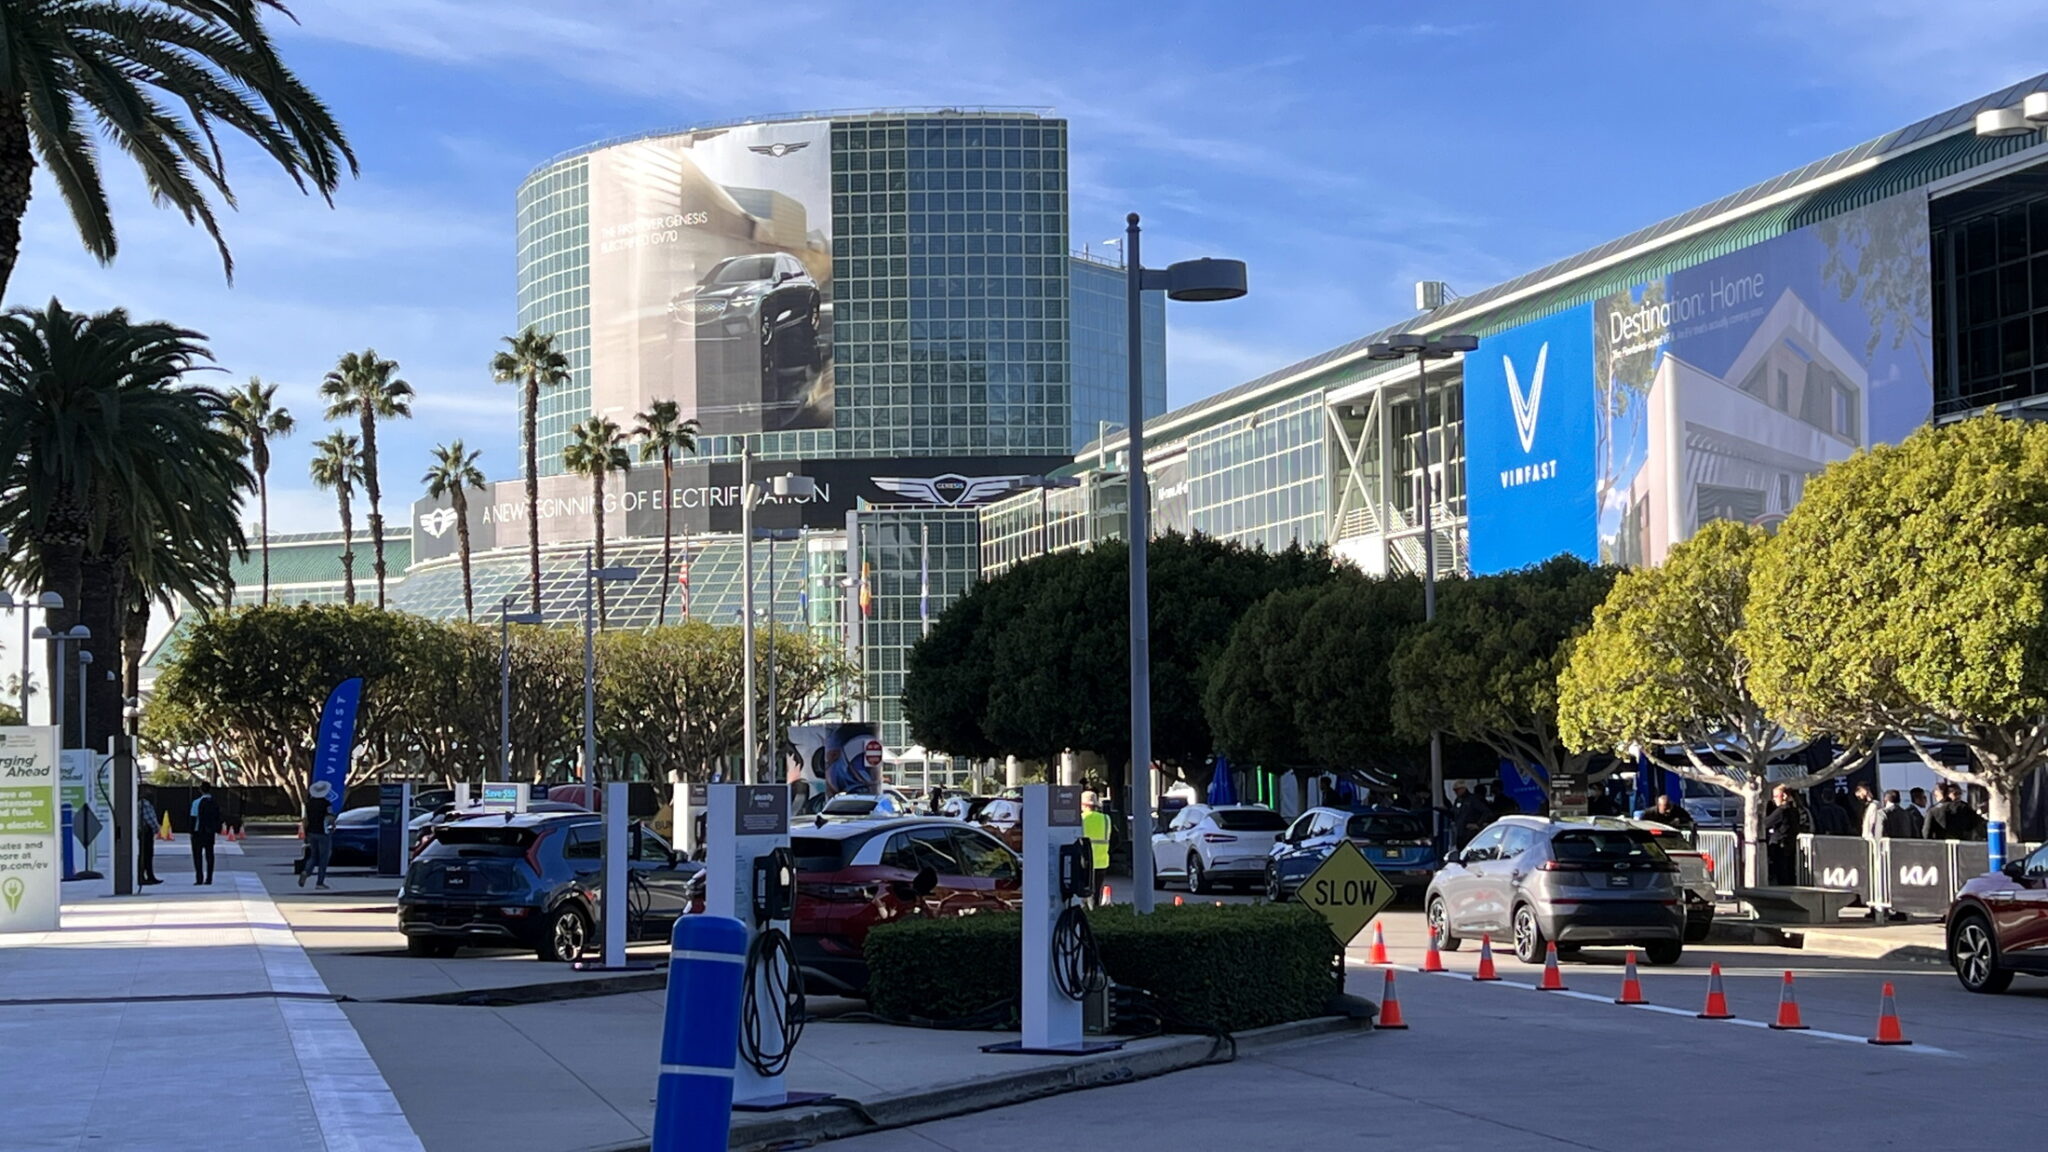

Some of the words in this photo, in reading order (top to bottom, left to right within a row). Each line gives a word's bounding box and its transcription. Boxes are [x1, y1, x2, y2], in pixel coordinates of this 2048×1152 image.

[666, 211, 708, 228] GENESIS
[651, 229, 678, 245] GV70
[1610, 291, 1706, 345] Destination:
[1710, 273, 1764, 313] Home
[1500, 459, 1557, 489] VINFAST
[482, 507, 491, 524] A
[493, 502, 524, 523] NEW
[526, 494, 617, 520] EGINNIG
[621, 490, 648, 512] OF
[326, 695, 347, 775] VINFAST
[5, 765, 51, 778] Ahead
[6, 820, 47, 830] electric.
[24, 841, 43, 849] and
[1823, 867, 1859, 887] KIA
[1900, 865, 1938, 886] KIA
[1315, 880, 1377, 906] SLOW
